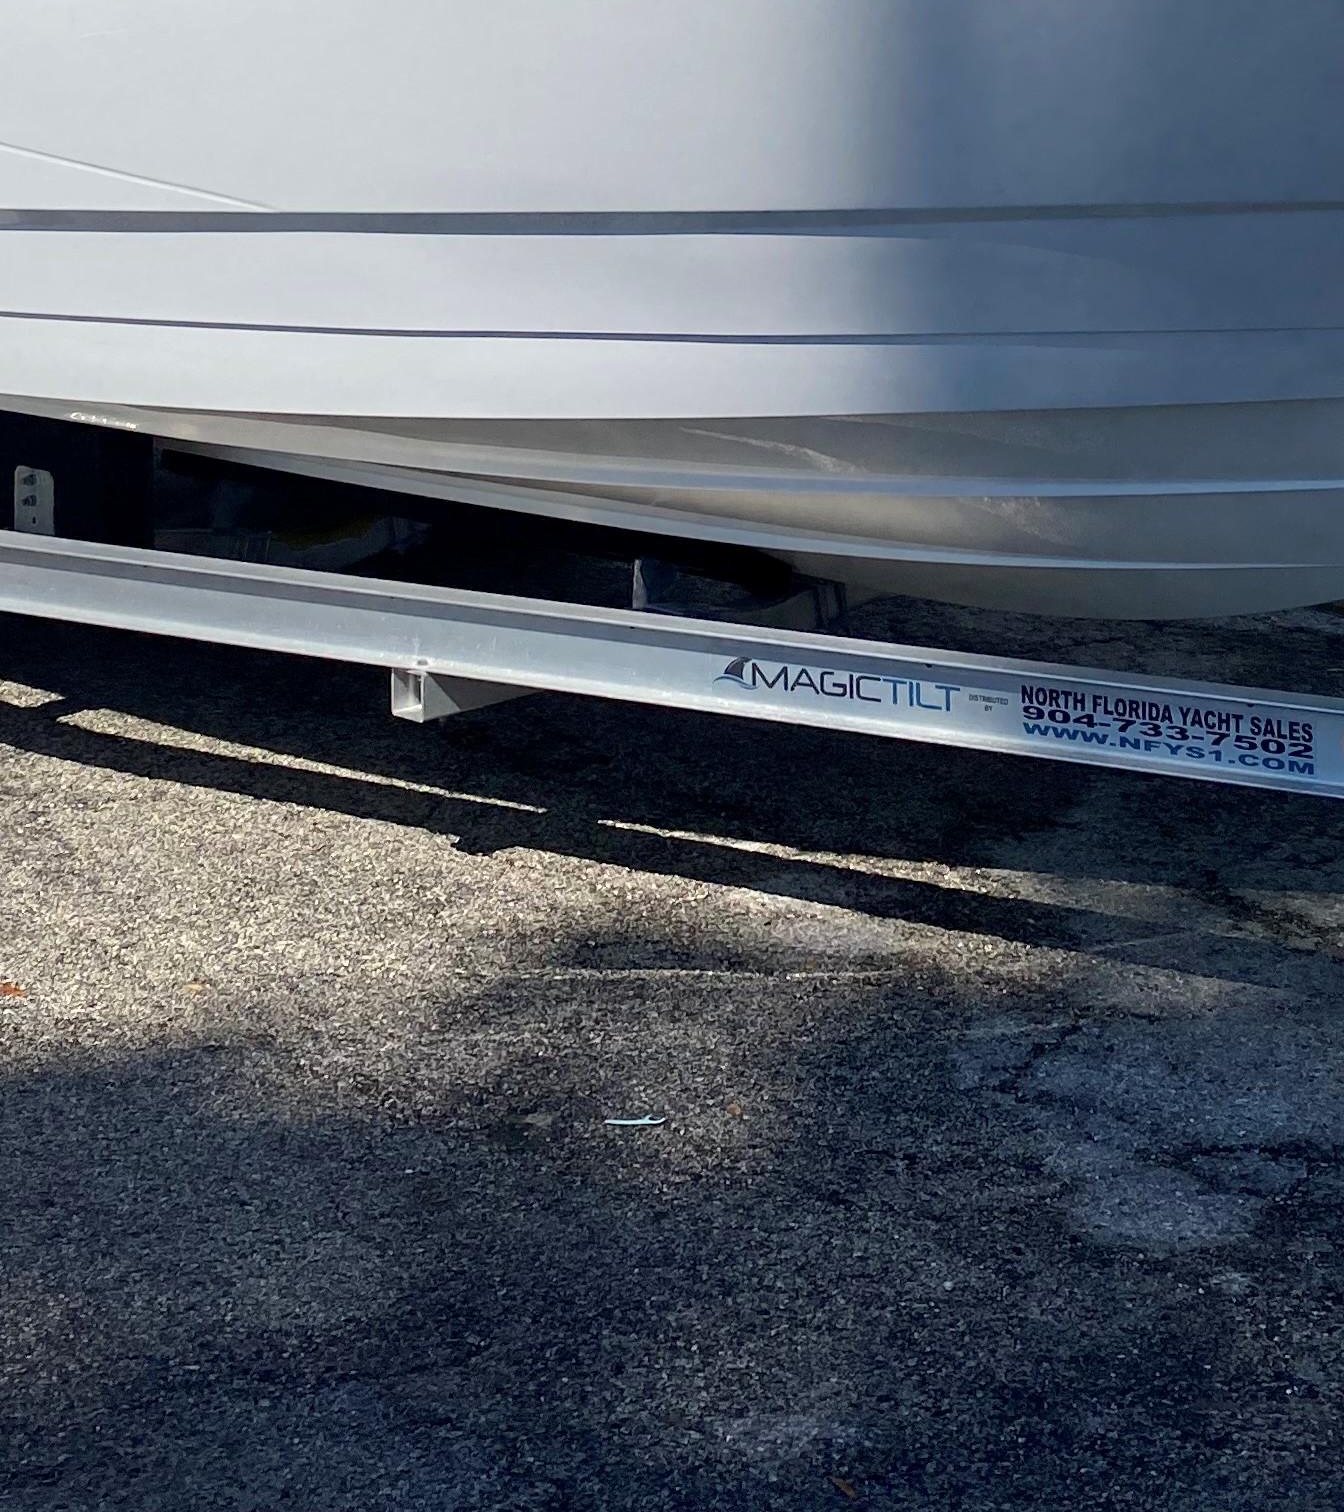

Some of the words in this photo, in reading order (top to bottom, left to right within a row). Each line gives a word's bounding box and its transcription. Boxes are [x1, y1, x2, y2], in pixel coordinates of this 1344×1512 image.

[751, 661, 961, 712] MAGICTILT
[1021, 685, 1086, 712] NORTH
[1092, 694, 1173, 724] FLORIDA
[1179, 706, 1244, 734] YACHT
[1249, 716, 1313, 743] SALES
[1022, 705, 1314, 760] 904-733-7502
